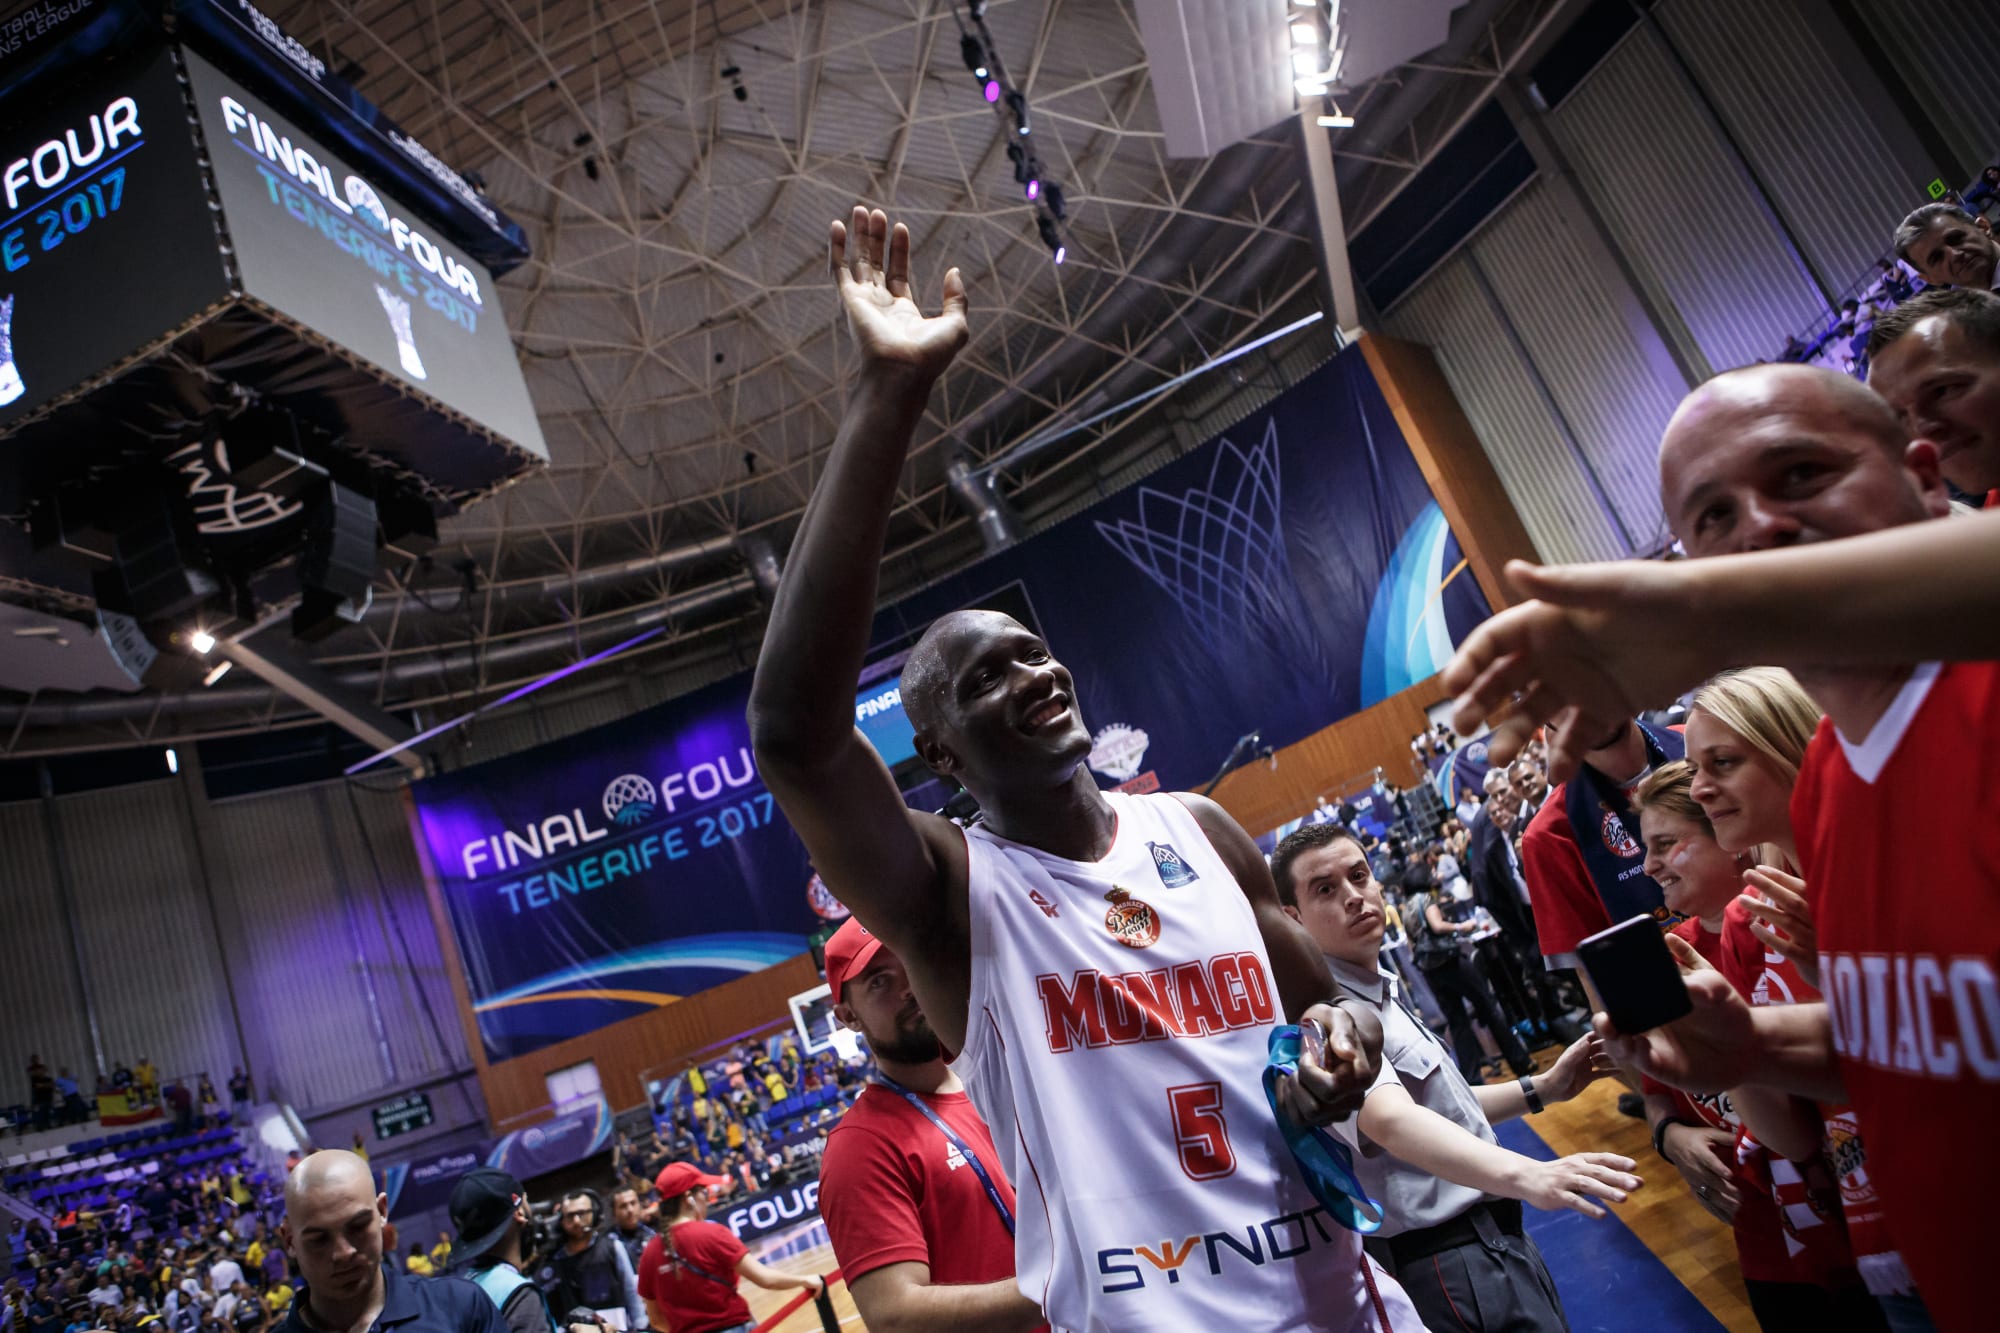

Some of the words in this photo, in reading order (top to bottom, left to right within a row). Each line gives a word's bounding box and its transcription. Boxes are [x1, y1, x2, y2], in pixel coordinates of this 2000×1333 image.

[0, 0, 56, 40] TBALL
[4, 97, 142, 209] FOUR
[220, 96, 354, 215] FINAL
[390, 217, 483, 305] FOUR
[36, 166, 126, 252] 2017
[256, 163, 419, 297] TENERIFE
[418, 274, 478, 334] 2017
[461, 807, 608, 880] FINAL
[661, 747, 758, 813] FOU
[500, 827, 689, 915] TENERIFE
[695, 792, 774, 848] 2017
[1036, 951, 1276, 1054] MONACO
[1167, 1081, 1237, 1182] 5
[1097, 1205, 1334, 1294] SYNOT
